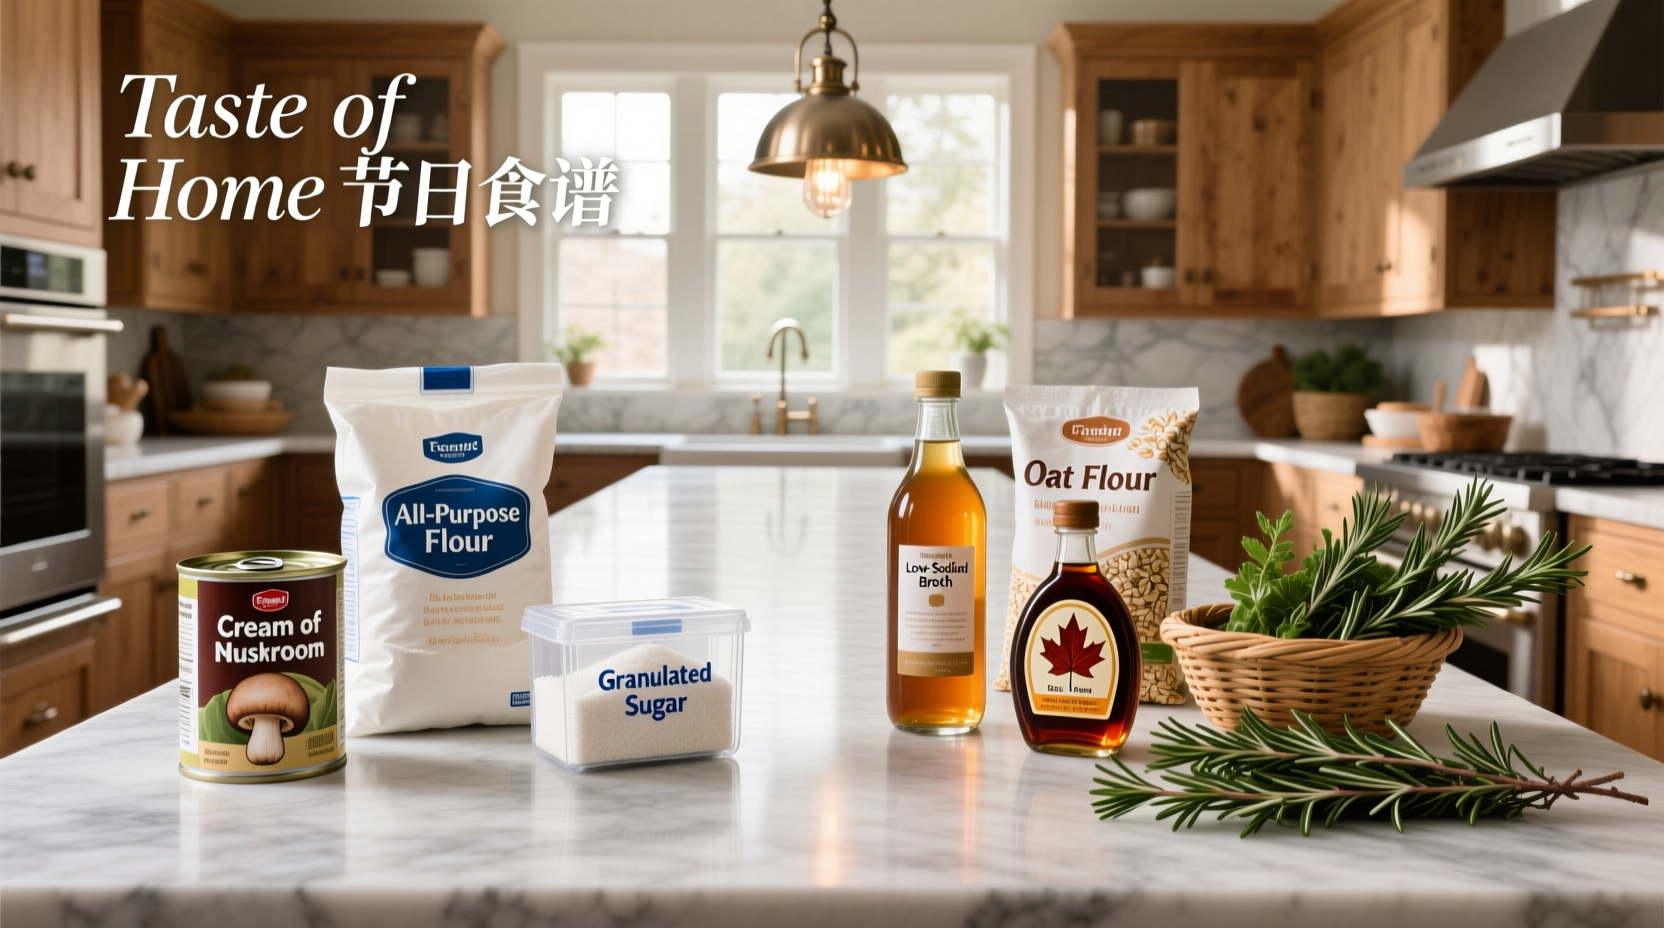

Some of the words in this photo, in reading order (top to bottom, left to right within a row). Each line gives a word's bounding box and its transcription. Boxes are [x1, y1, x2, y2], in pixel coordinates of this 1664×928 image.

[1024, 459, 1075, 489] Oat
[1082, 464, 1157, 491] Flour
[394, 503, 521, 530] All-Purpose
[425, 528, 494, 553] Flour
[919, 575, 953, 588] Broth
[217, 614, 294, 638] Cream
[300, 609, 322, 635] of
[215, 641, 325, 663] Nuskroom
[598, 661, 712, 691] Granulated
[625, 694, 688, 721] Sugar
